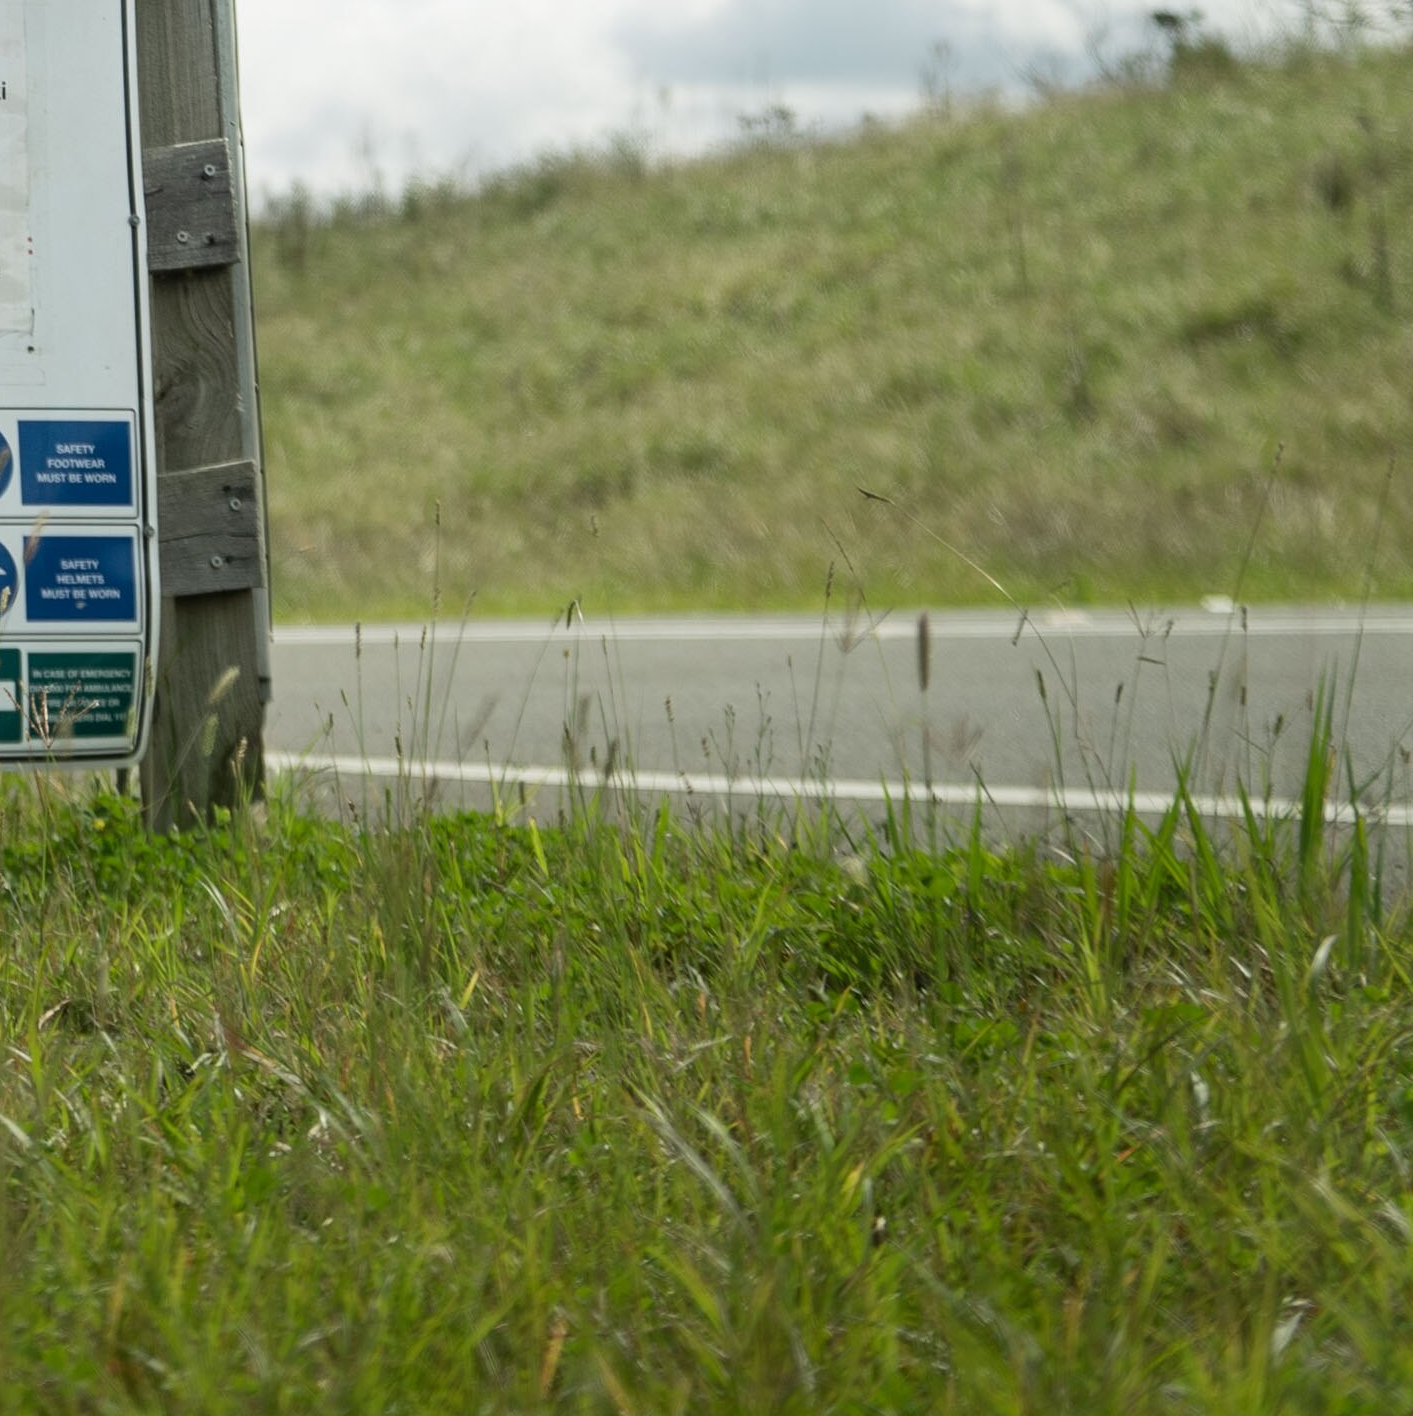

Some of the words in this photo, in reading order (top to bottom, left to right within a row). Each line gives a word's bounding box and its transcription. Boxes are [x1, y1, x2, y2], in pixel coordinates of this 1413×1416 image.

[56, 444, 95, 455] SAFETY
[47, 459, 106, 469] FOOTWEAR
[37, 473, 66, 484] MUST
[69, 473, 83, 484] BE
[85, 473, 117, 484] WORN
[61, 560, 99, 570] SAFETY
[56, 574, 105, 585] HELMETS
[41, 589, 70, 600] MUST
[73, 589, 87, 599] BE
[89, 589, 120, 599] WORN
